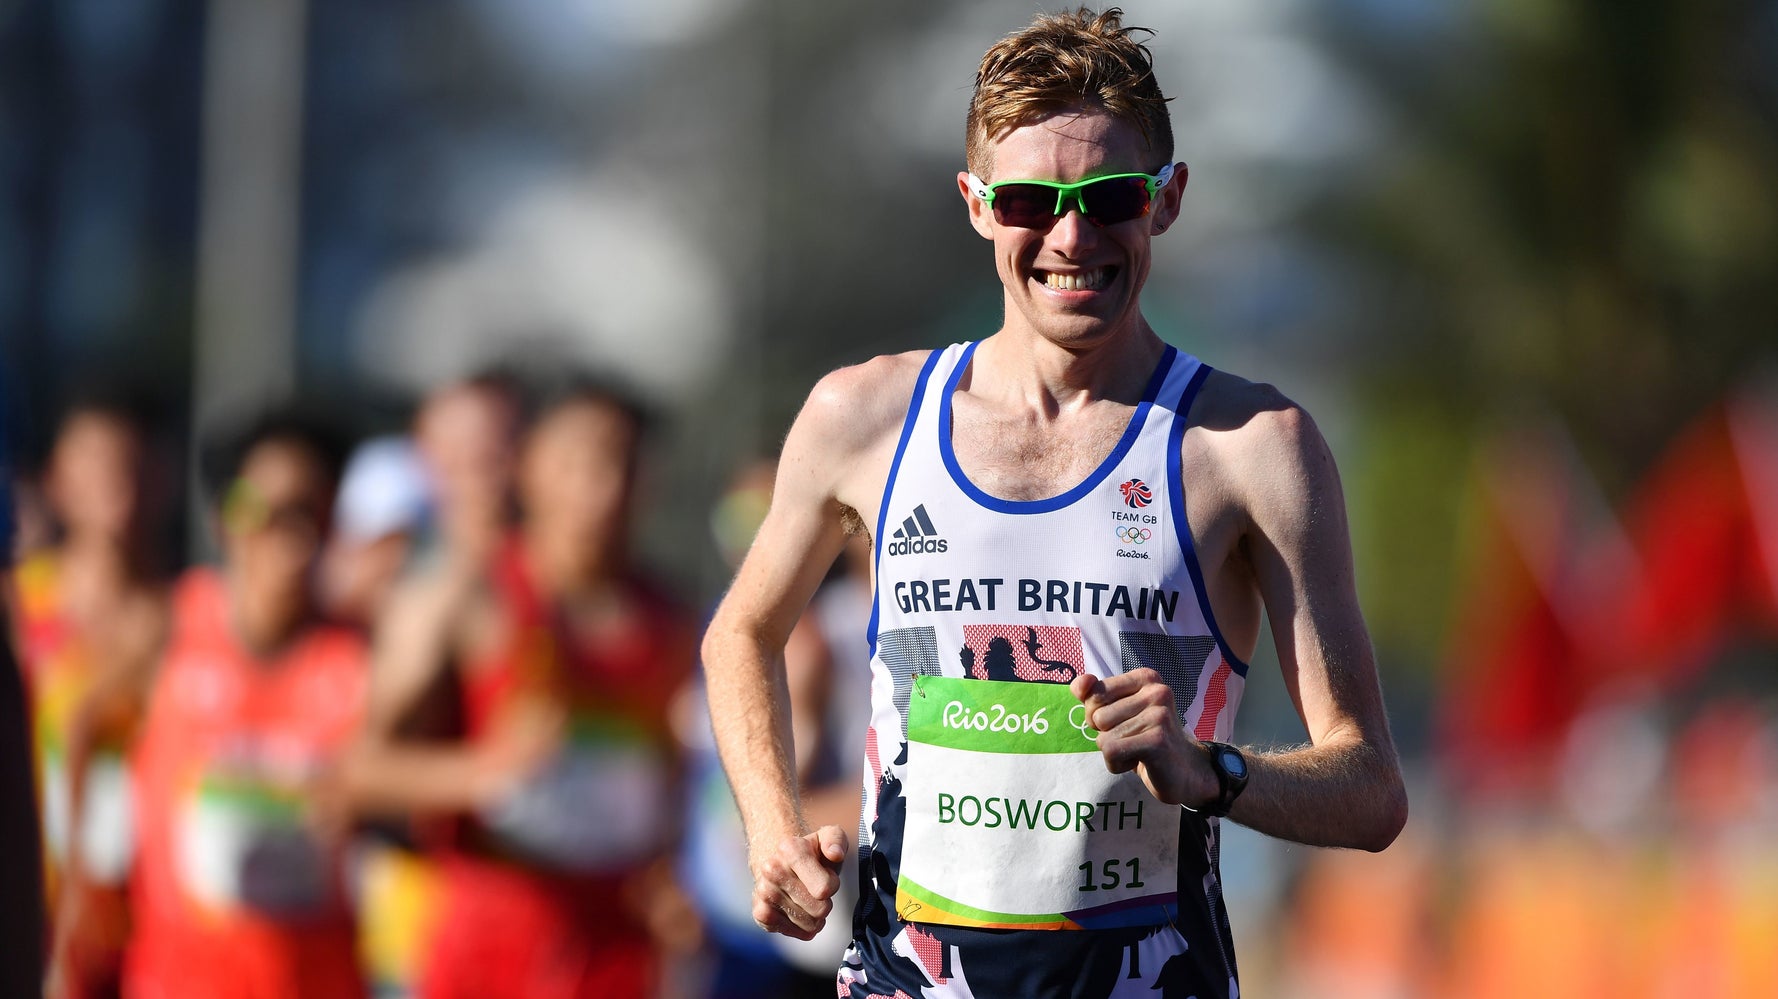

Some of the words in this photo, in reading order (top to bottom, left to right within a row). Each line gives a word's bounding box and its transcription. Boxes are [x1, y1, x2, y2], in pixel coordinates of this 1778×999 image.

[1111, 511, 1139, 522] TEAM
[1142, 514, 1158, 525] GB
[888, 534, 948, 556] adidas
[894, 578, 1004, 614] GREAT
[1017, 579, 1180, 622] BRITAIN
[942, 700, 1049, 735] Rio2016
[937, 793, 1144, 832] BOSWORTH
[1078, 857, 1145, 892] 151
